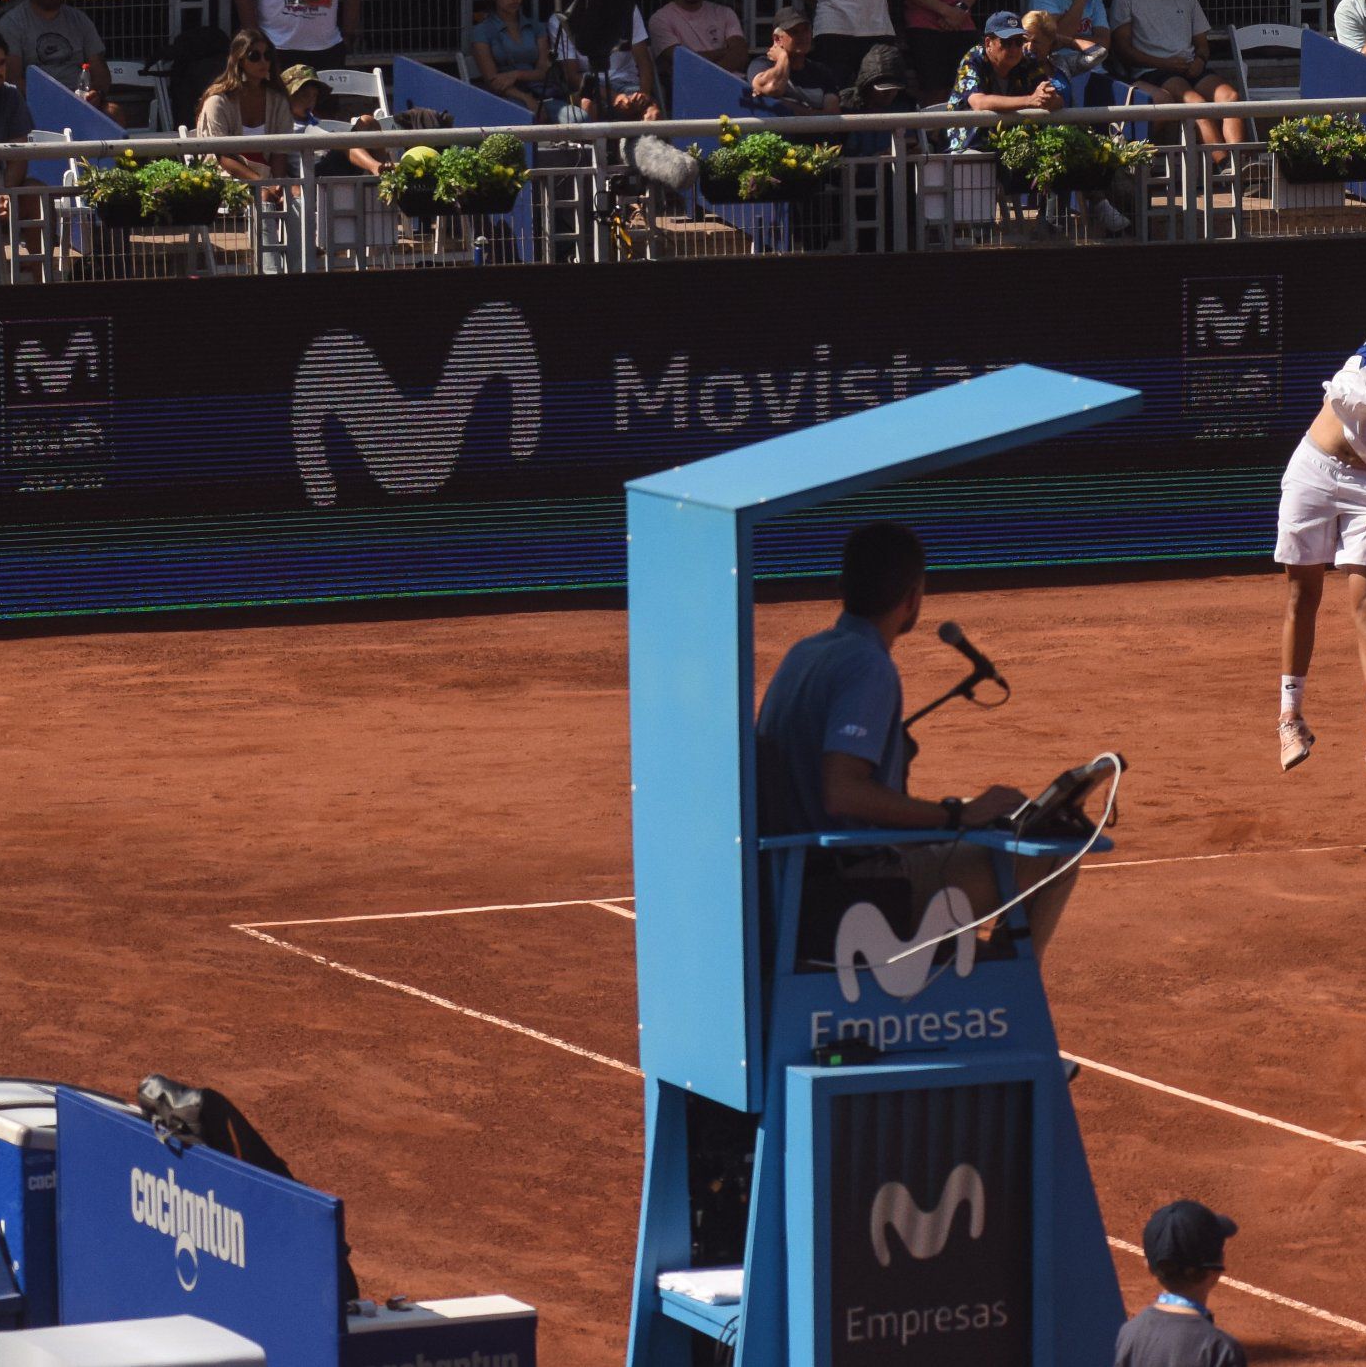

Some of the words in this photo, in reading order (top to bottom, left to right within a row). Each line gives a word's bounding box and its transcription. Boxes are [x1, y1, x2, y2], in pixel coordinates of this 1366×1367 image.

[612, 343, 1019, 432] Movist
[810, 1007, 1009, 1053] Empresas
[846, 1298, 1008, 1346] Empresas
